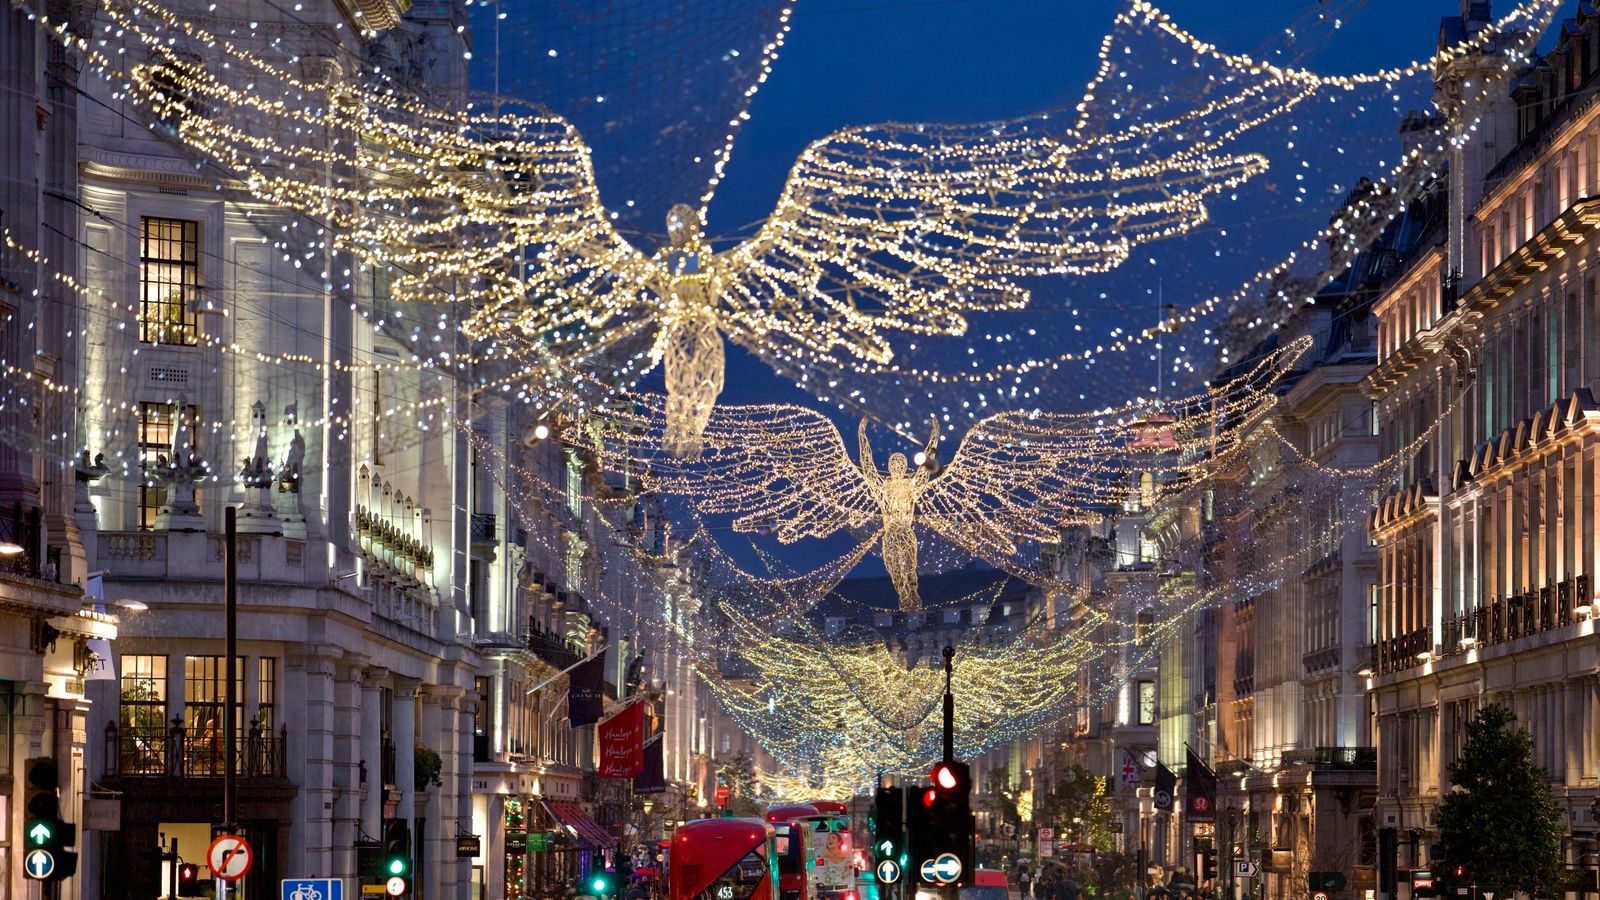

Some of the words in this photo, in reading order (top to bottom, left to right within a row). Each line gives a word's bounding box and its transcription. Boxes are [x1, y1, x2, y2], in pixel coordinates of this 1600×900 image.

[605, 728, 632, 741] Hamleys
[604, 744, 632, 759] Hamleys
[604, 762, 632, 776] Hamleys
[1241, 863, 1248, 872] P
[718, 886, 733, 899] 453
